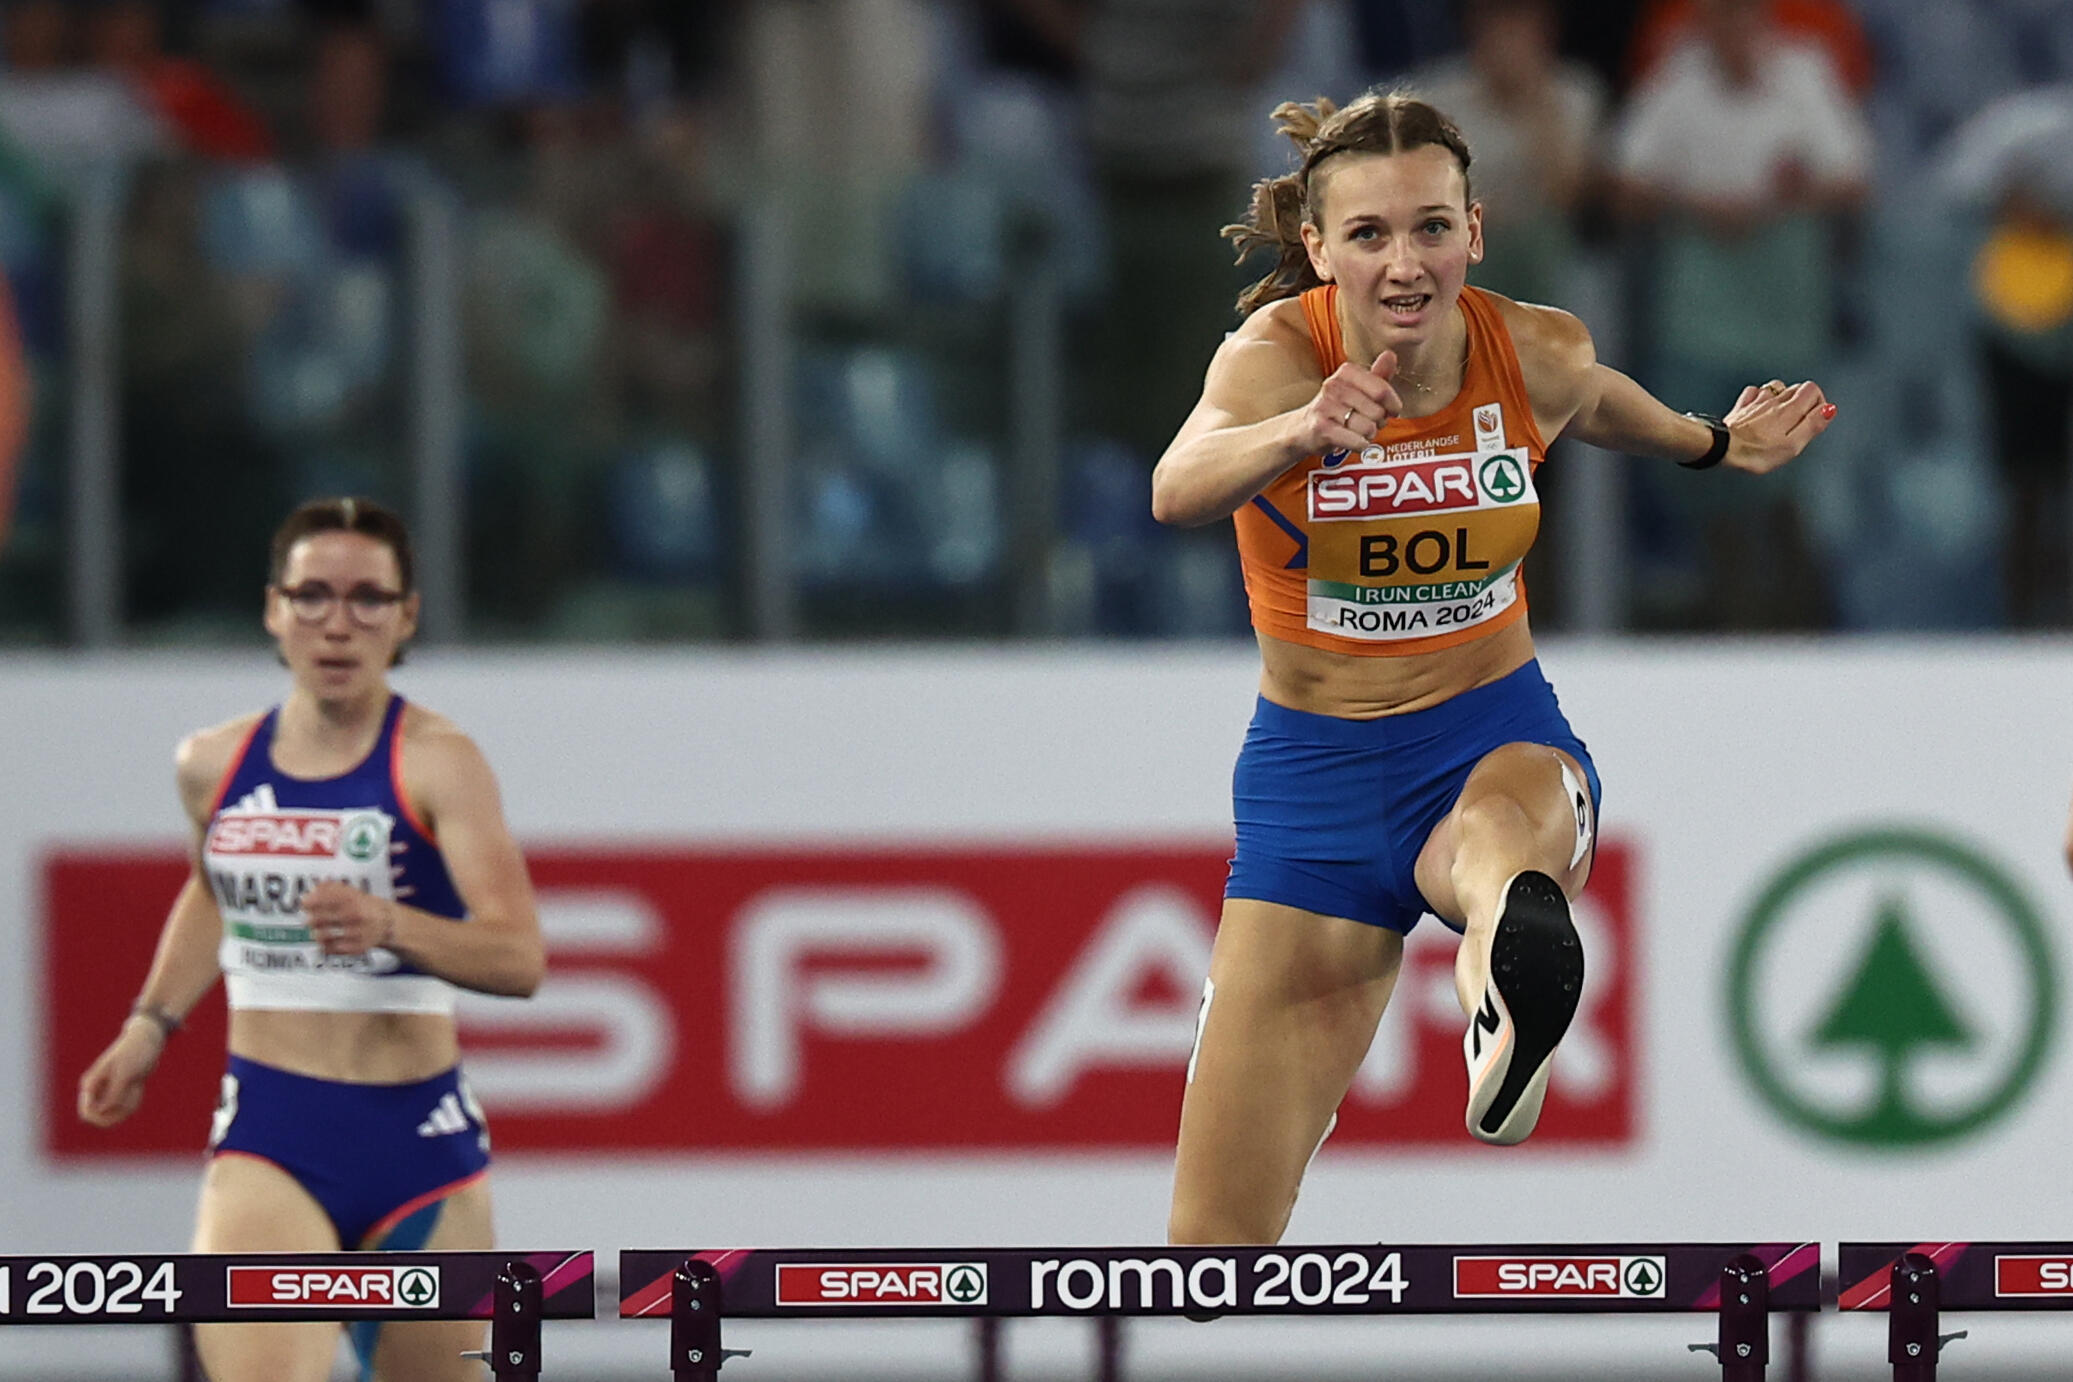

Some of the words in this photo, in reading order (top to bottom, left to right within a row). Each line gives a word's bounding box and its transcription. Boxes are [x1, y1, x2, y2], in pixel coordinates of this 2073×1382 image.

[1386, 434, 1460, 453] NEDERLANDSE
[1318, 466, 1474, 512] SPAR
[1359, 528, 1489, 577] BOL
[1355, 588, 1362, 602] I
[1365, 587, 1411, 602] RUN
[1415, 582, 1483, 601] CLEAN
[1339, 607, 1428, 632] ROMA
[1435, 589, 1496, 626] 2024
[212, 819, 339, 852] SPAR
[26, 1262, 182, 1314] 2024
[271, 1273, 390, 1300] SPAR
[819, 1270, 938, 1297] SPAR
[1030, 1258, 1236, 1309] roma
[1253, 1253, 1409, 1305] 2024
[1498, 1263, 1617, 1290] SPAR
